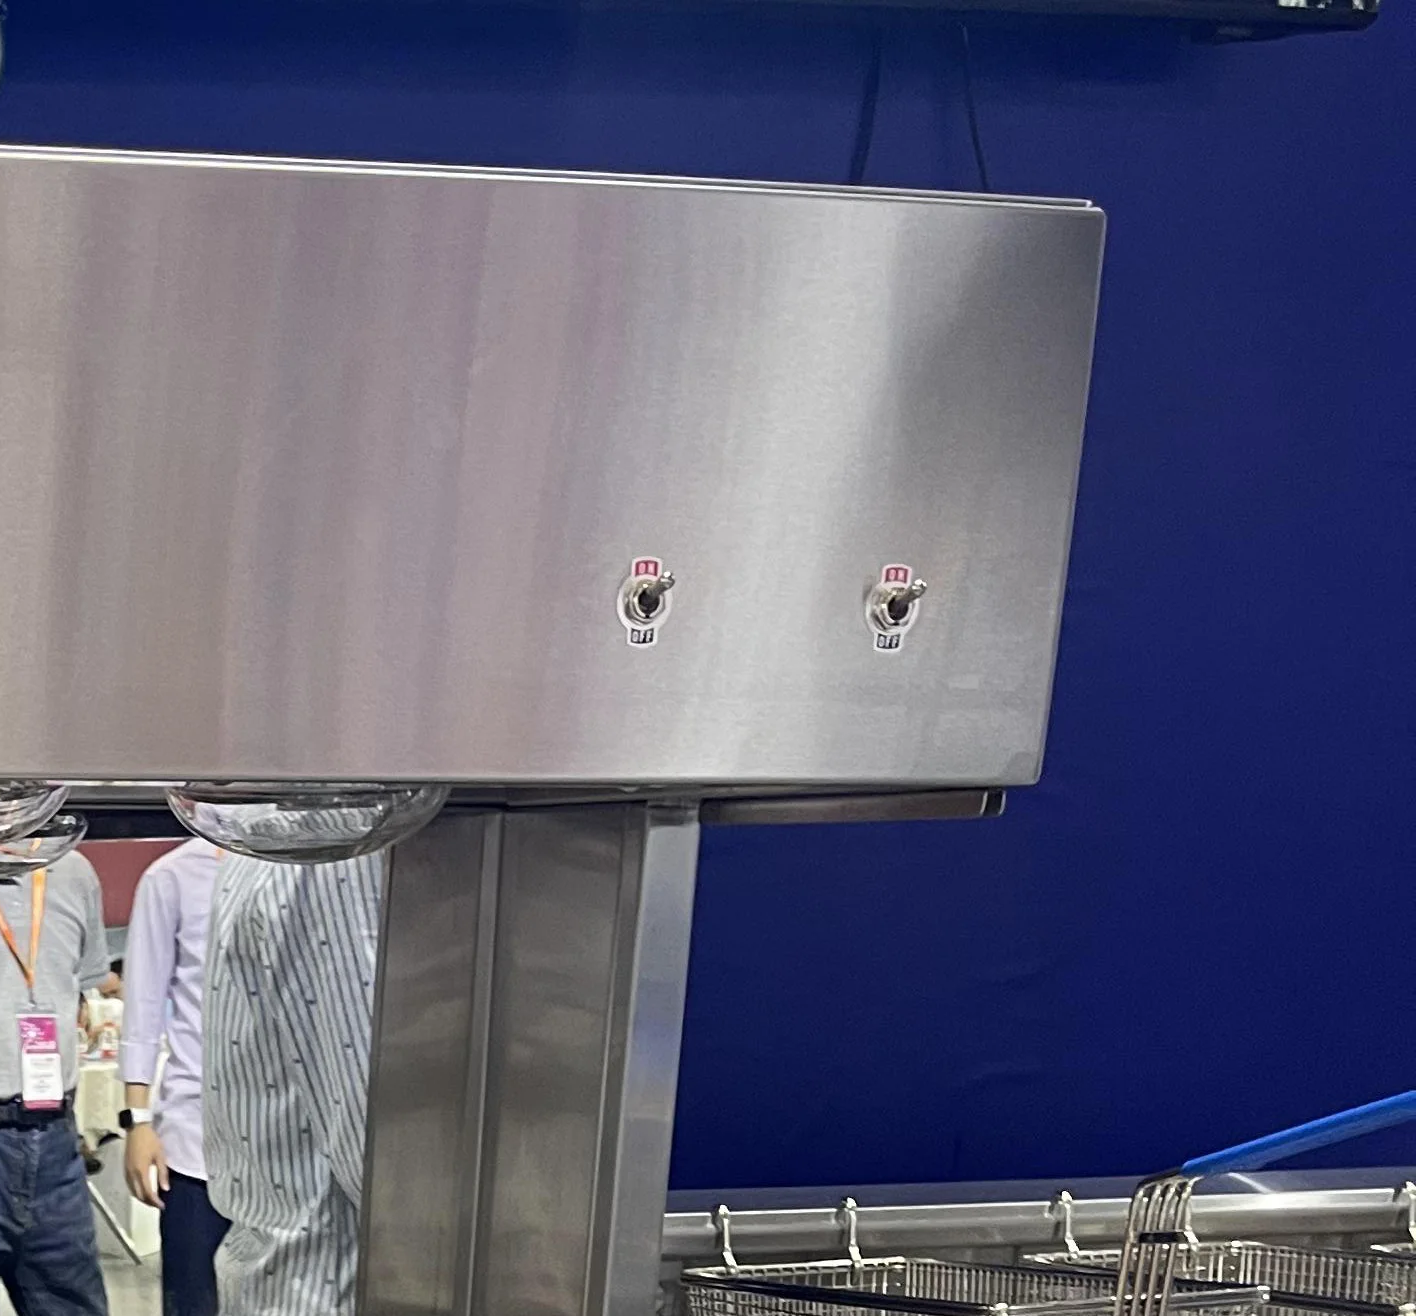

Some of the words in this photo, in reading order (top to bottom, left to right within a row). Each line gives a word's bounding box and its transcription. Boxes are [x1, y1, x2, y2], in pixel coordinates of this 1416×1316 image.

[636, 561, 657, 576] ON
[887, 567, 907, 583] ON
[631, 628, 654, 643] OFF
[878, 634, 900, 648] OFF
